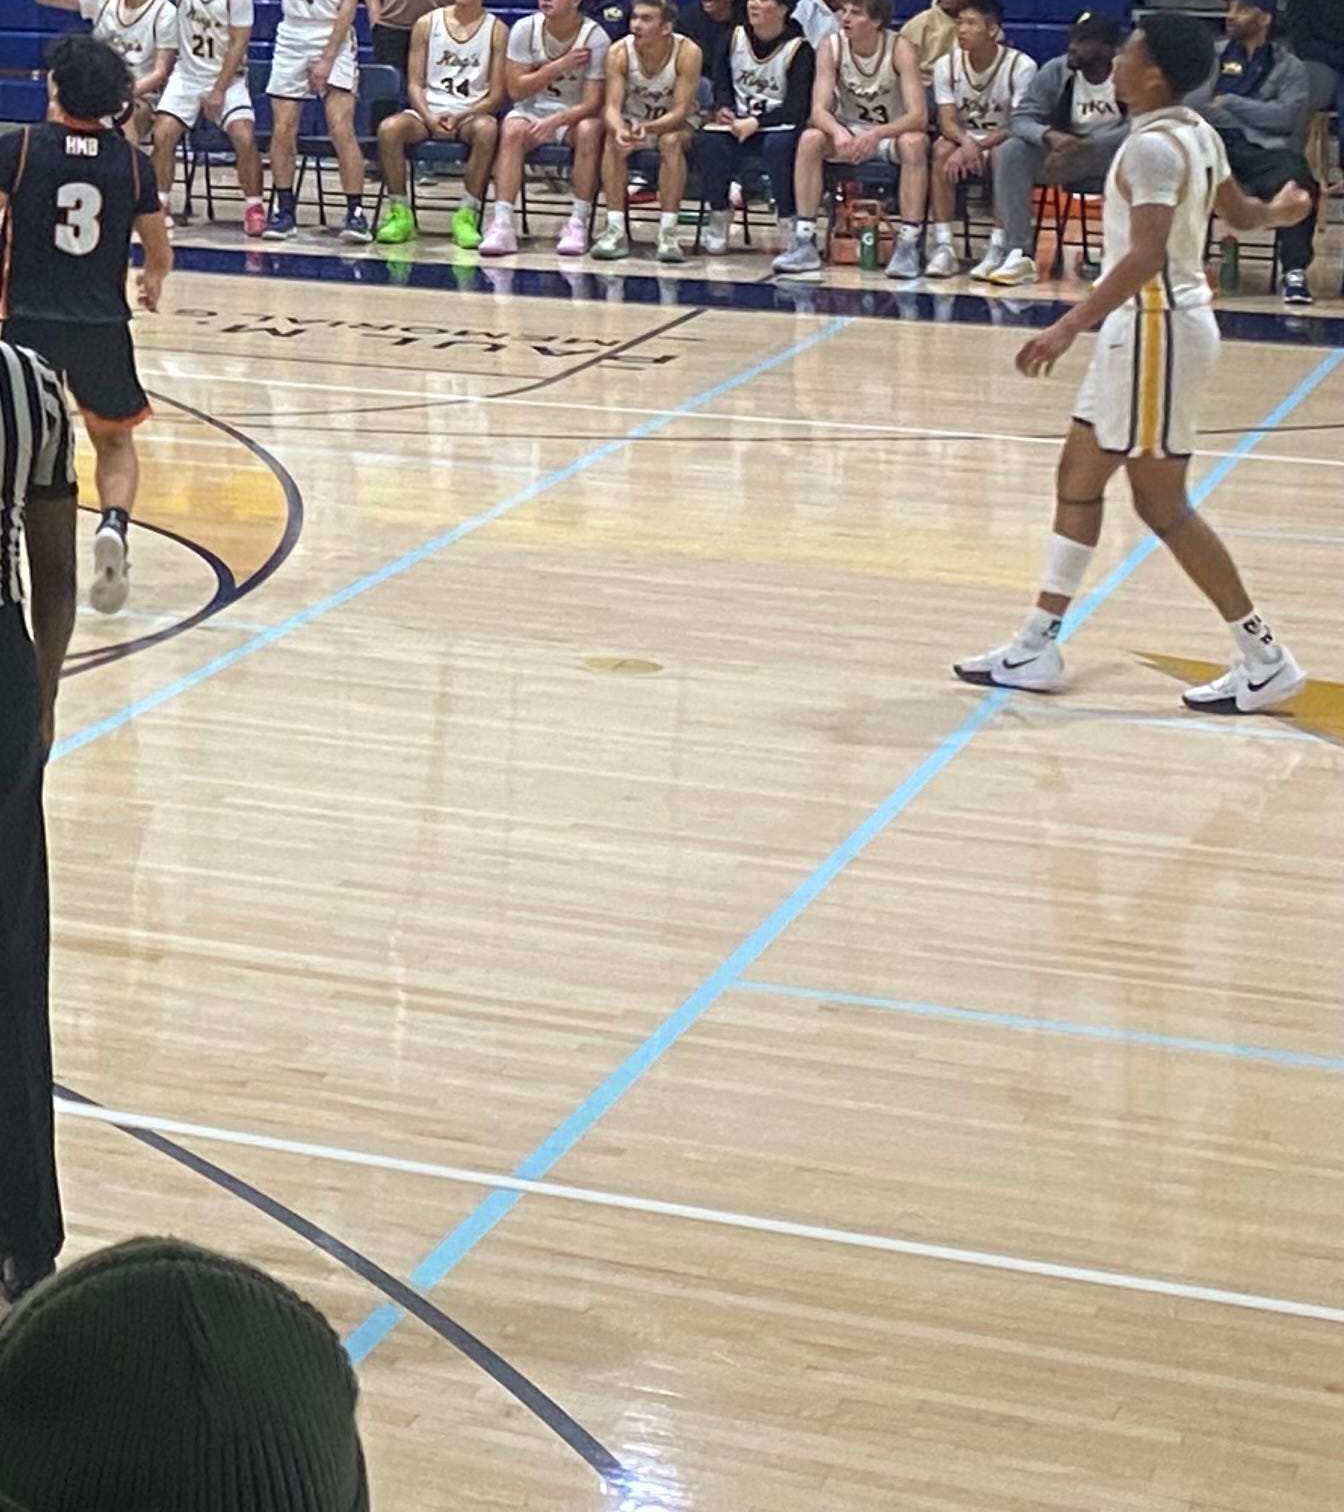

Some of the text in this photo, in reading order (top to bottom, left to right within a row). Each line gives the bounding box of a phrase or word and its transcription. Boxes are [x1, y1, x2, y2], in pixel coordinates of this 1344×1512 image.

[192, 35, 215, 59] 21
[441, 77, 470, 97] 34
[855, 104, 889, 125] 23
[1076, 100, 1117, 116] TKA
[65, 135, 99, 157] HMB
[55, 182, 103, 256] 3
